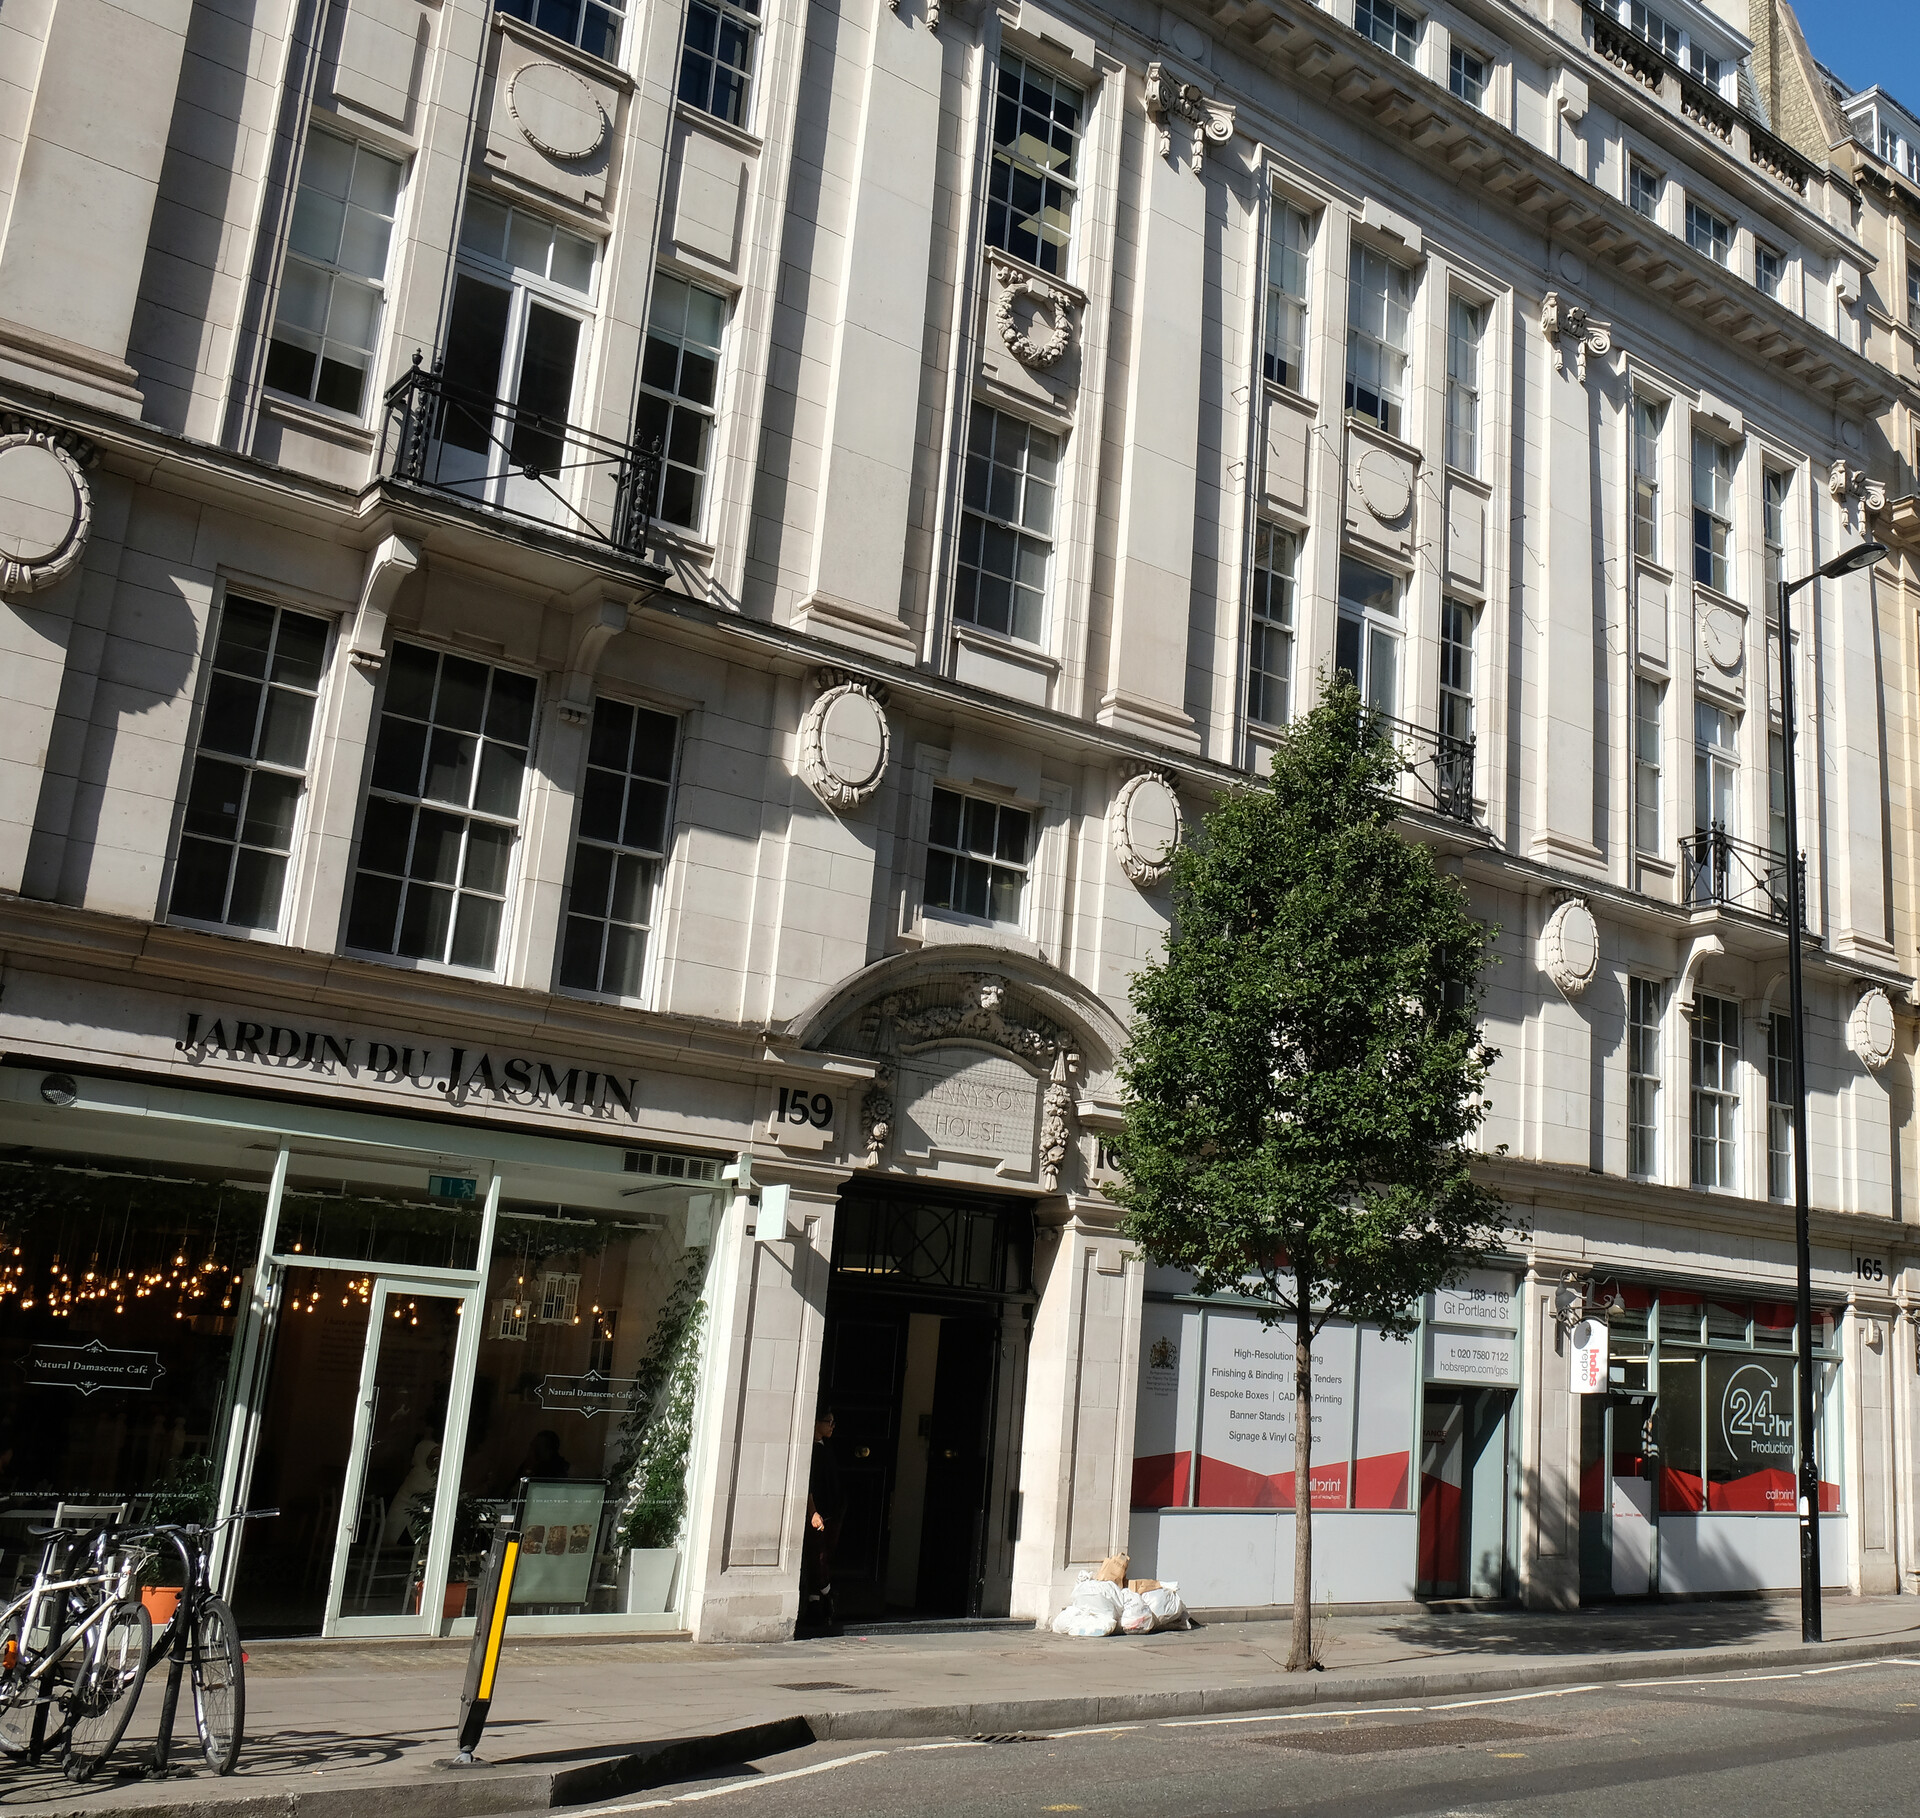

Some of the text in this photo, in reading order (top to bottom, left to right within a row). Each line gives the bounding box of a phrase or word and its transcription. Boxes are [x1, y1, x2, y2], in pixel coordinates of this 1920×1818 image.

[175, 1012, 640, 1113] JARDIN DU JASMIN
[917, 1076, 1028, 1113] TENNYSON
[777, 1087, 833, 1128] 159
[935, 1114, 1004, 1144] HOUSE
[1856, 1257, 1883, 1282] 165
[1469, 1288, 1486, 1301] 163
[1443, 1301, 1509, 1319] Gt Portland St
[1234, 1348, 1294, 1361] High-Resolution
[1457, 1349, 1471, 1359] 020
[1472, 1350, 1490, 1360] 7580
[1492, 1351, 1509, 1361] 7122
[34, 1359, 149, 1374] Natural Damascene Café
[1440, 1361, 1509, 1377] hobsrepro.com/gps
[1580, 1349, 1589, 1381] repro
[1589, 1349, 1599, 1387] hobs
[1211, 1368, 1246, 1380] Finishing
[1248, 1370, 1253, 1379] &
[1255, 1370, 1284, 1382] Binding
[1314, 1374, 1343, 1384] Tenders
[548, 1388, 575, 1396] Natural
[577, 1389, 615, 1399] Damascene
[1209, 1388, 1244, 1400] Bespoke
[1245, 1390, 1269, 1400] Boxes
[1278, 1392, 1296, 1401] CAD
[1315, 1394, 1343, 1406] Printing
[1230, 1410, 1257, 1420] Banner
[1258, 1411, 1285, 1422] Stands
[1229, 1431, 1261, 1443] Signage
[1261, 1432, 1268, 1441] &
[1269, 1432, 1287, 1444] Vinyl
[1751, 1440, 1794, 1455] Production
